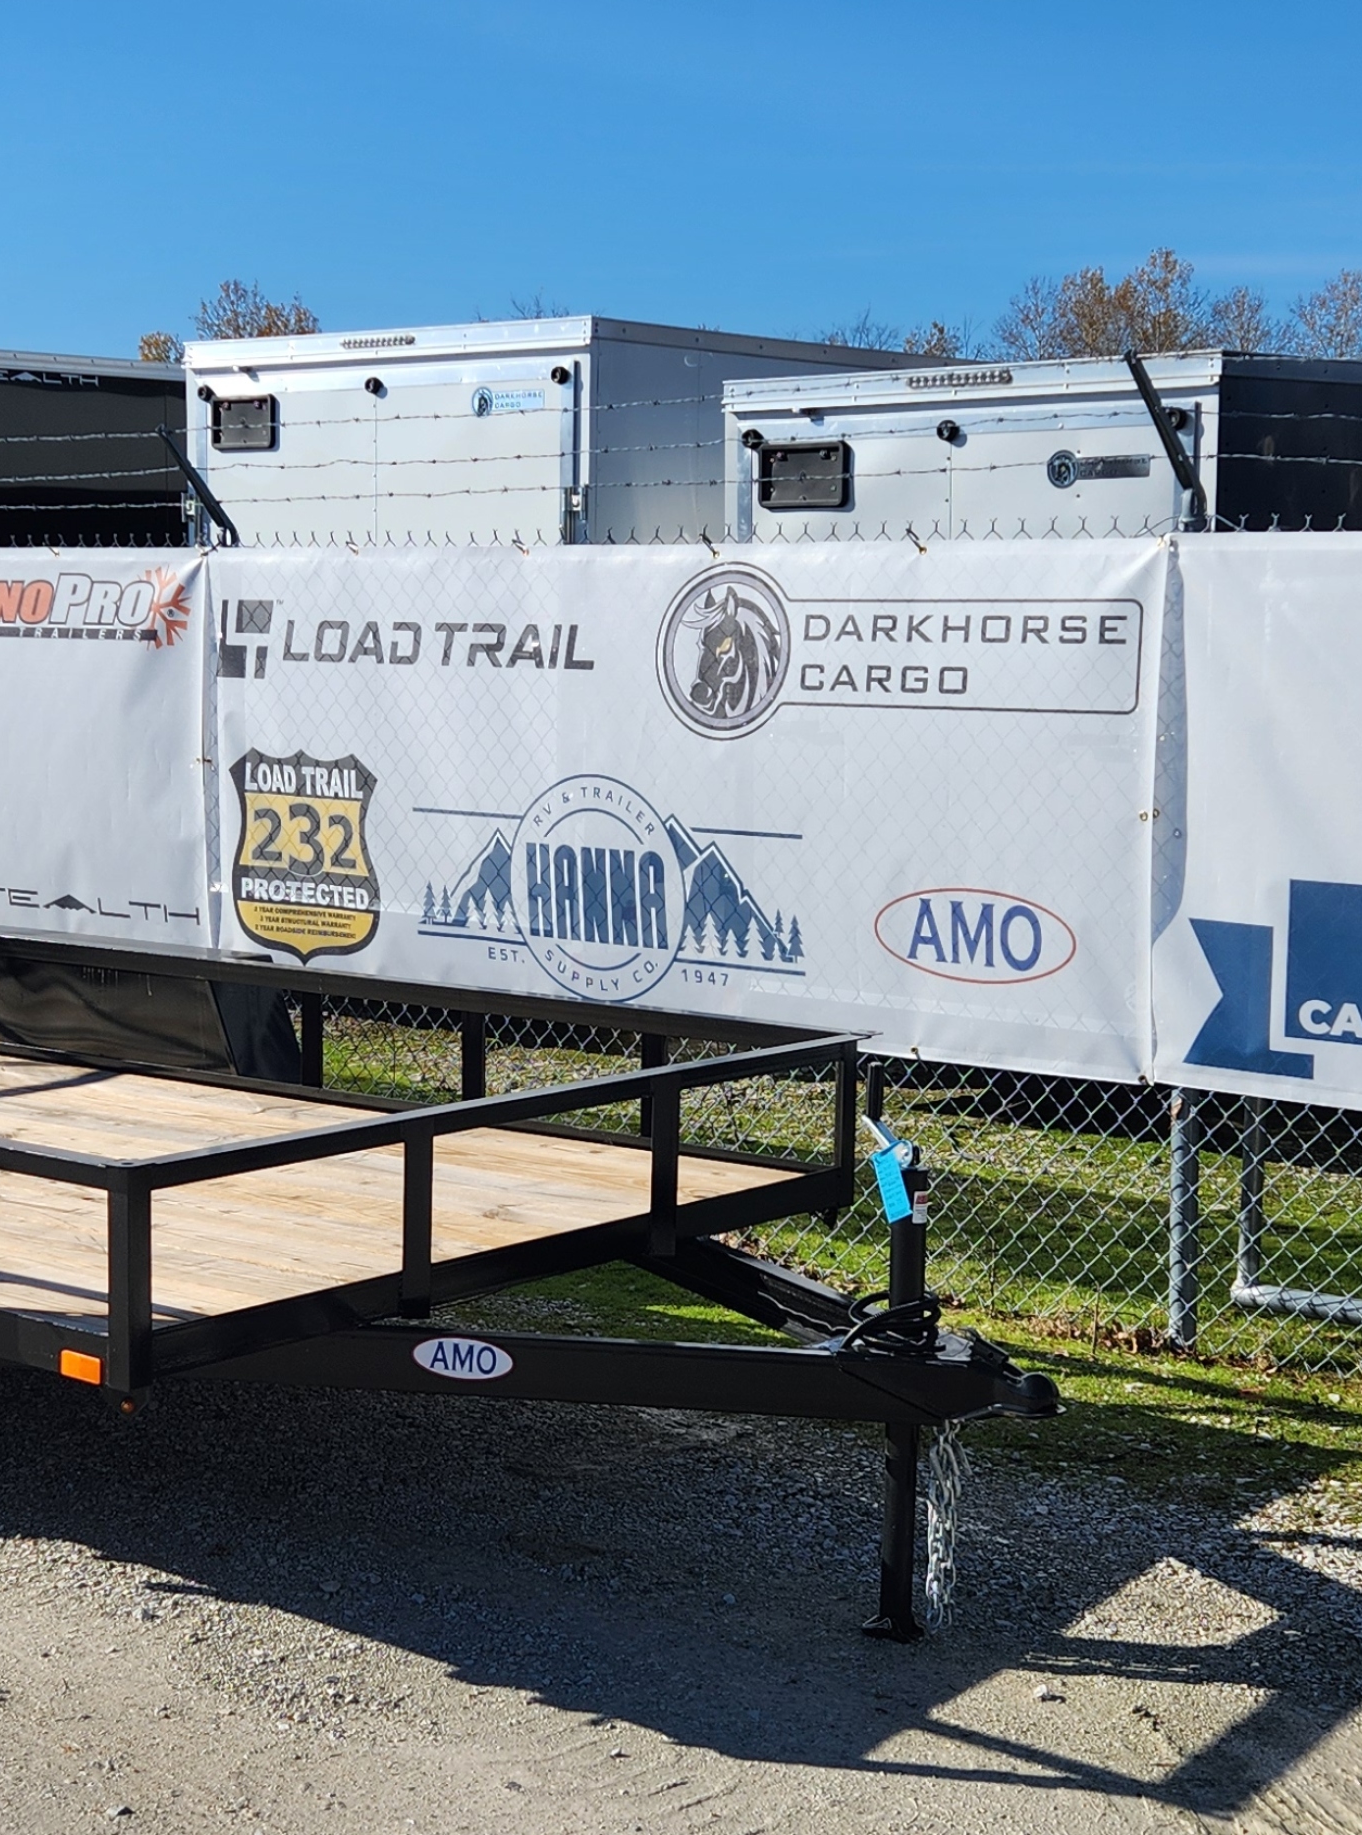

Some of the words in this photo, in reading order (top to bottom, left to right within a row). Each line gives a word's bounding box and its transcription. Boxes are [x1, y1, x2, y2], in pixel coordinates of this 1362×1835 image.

[18, 627, 142, 640] TRAILERS
[283, 619, 423, 665] LOAD
[434, 622, 595, 671] TRAIL
[803, 614, 1128, 645] DARKHORSE
[800, 663, 968, 695] CARGO
[244, 762, 297, 794] LOAD
[301, 766, 364, 799] TRAIL
[533, 803, 552, 827] RV
[562, 792, 573, 804] &
[580, 786, 656, 836] TRAILER
[252, 803, 357, 876] 232
[241, 877, 369, 910] PROTECTED
[526, 842, 669, 950] HANNA
[907, 897, 1042, 971] AMO
[488, 946, 526, 964] EST.
[545, 949, 621, 991] SUPPLY
[633, 960, 659, 983] CO.
[681, 968, 730, 987] 1947
[430, 1341, 497, 1375] AMO
